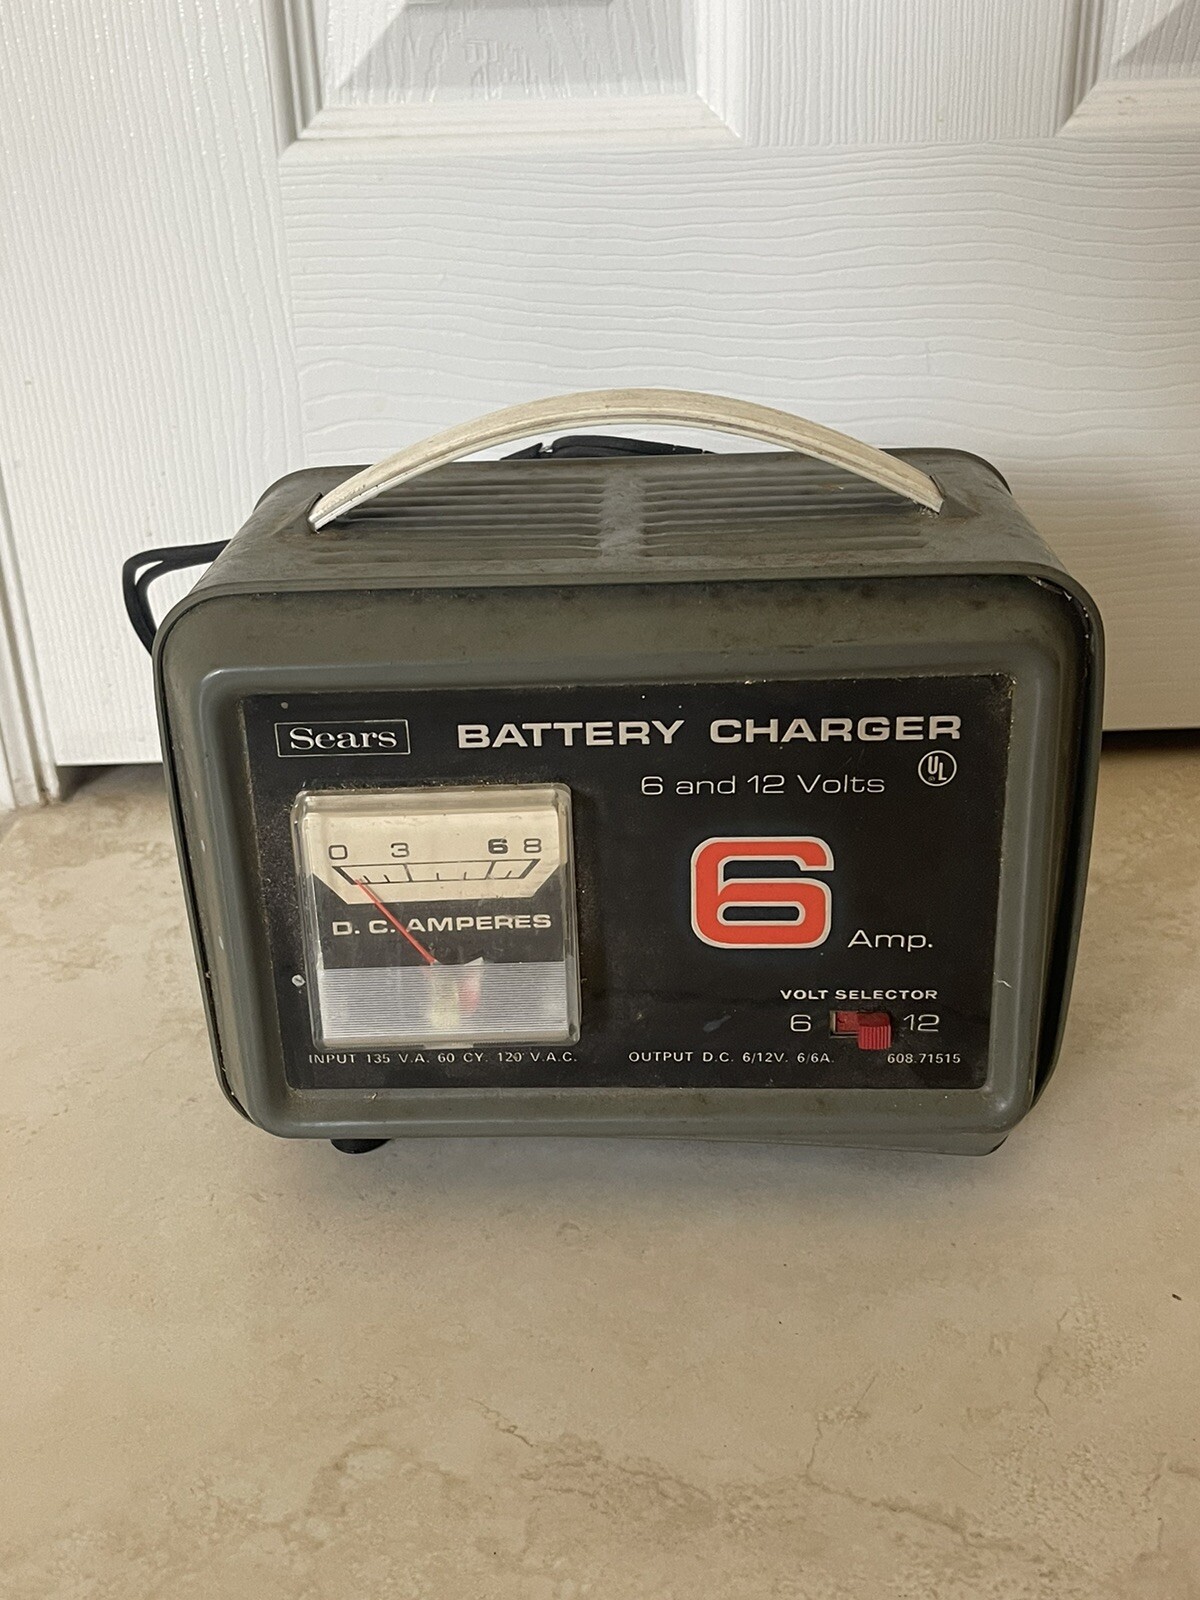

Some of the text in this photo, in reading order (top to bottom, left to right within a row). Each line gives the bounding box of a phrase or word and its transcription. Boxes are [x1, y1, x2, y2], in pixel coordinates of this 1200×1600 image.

[289, 726, 398, 750] Sears
[457, 715, 962, 749] BATTERY CHARGER
[927, 755, 948, 782] UL
[641, 774, 886, 796] 6 and 12 Volts
[390, 842, 410, 858] 3
[487, 838, 508, 855] 6
[523, 838, 542, 854] 8
[690, 836, 835, 949] 6
[405, 914, 552, 933] AMPERES
[847, 929, 934, 952] Amp.
[780, 989, 938, 1000] VOLT SELECTOR
[790, 1014, 941, 1032] 6 12
[309, 1052, 578, 1064] INPUT 135 V.A. 60 CY. 120 V.A.C.
[628, 1052, 694, 1062] OUTPUT
[702, 1053, 734, 1063] D.C.
[742, 1052, 789, 1063] 6/12V.
[887, 1054, 962, 1065] 608.71515
